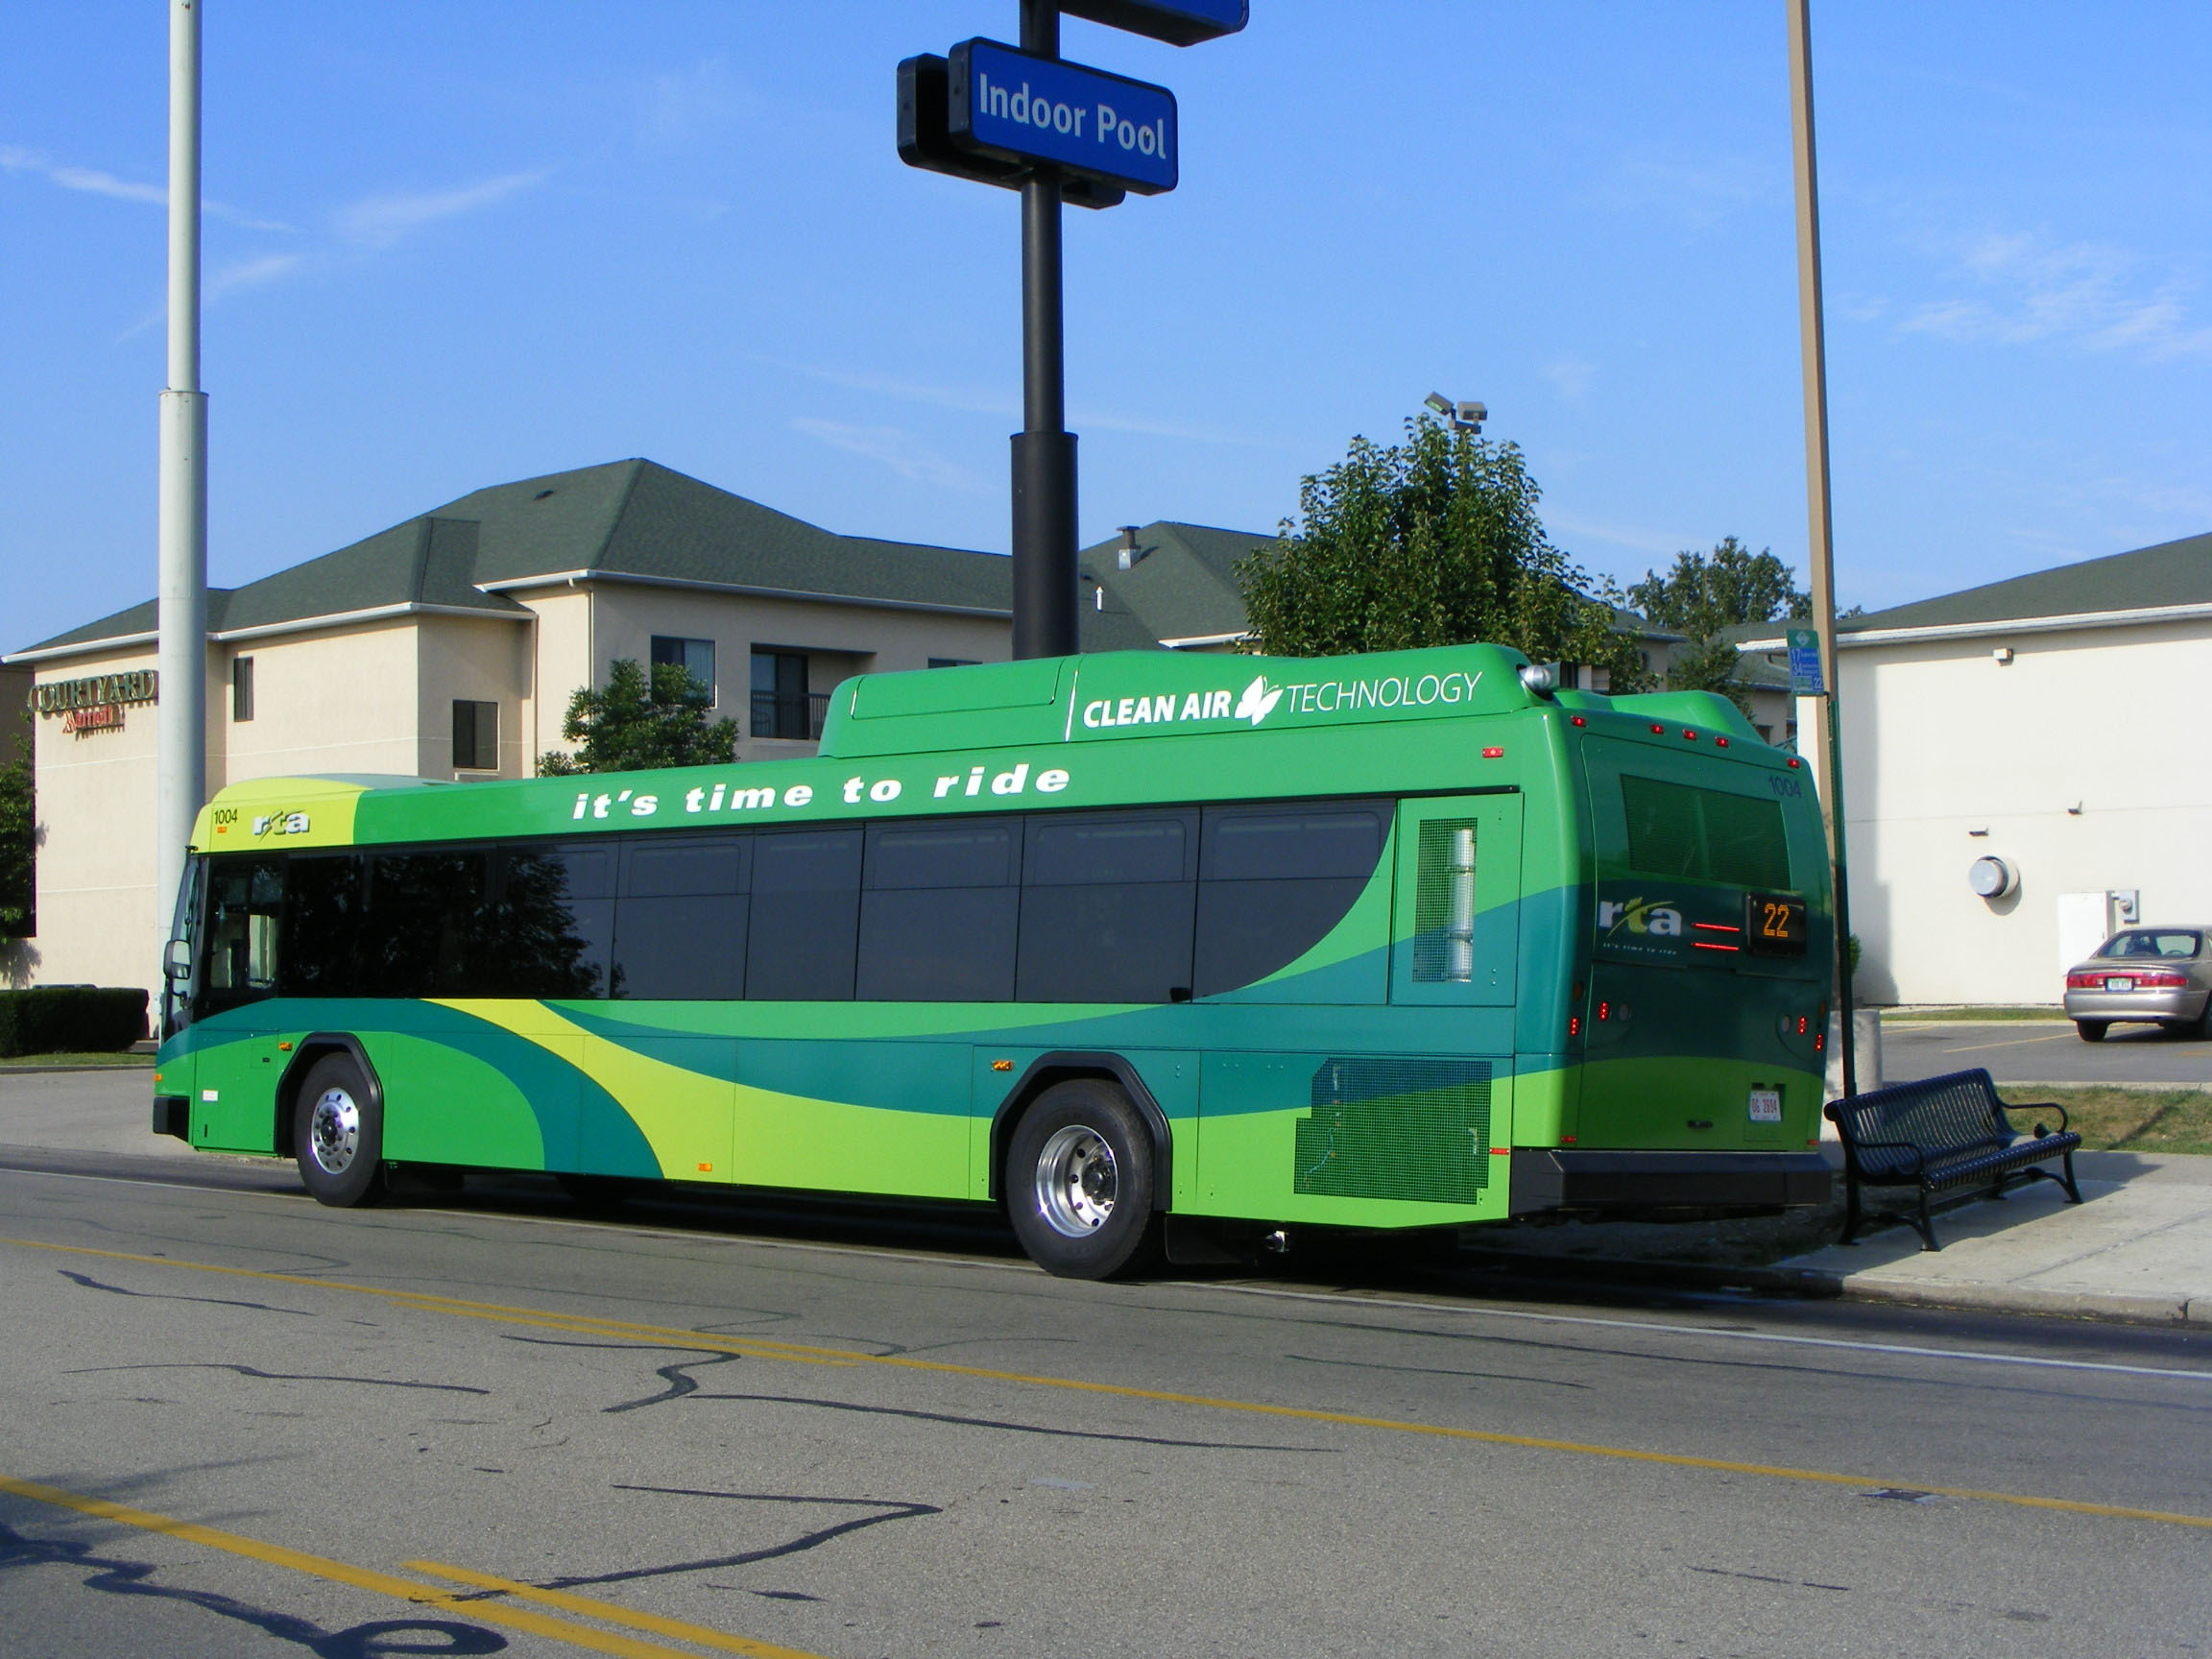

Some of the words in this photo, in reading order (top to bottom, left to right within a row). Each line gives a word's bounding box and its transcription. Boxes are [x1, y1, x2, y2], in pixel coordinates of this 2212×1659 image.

[979, 73, 1087, 138] Indoor
[1096, 103, 1166, 160] Pool
[27, 669, 156, 712] COURTYARD
[1083, 694, 1178, 729] CLEAN
[1180, 689, 1234, 721] AIR
[1286, 671, 1484, 714] TECHNOLOGY
[1813, 677, 1822, 689] 22
[571, 790, 660, 821] it's
[685, 782, 814, 814] time
[842, 775, 903, 805] to
[932, 763, 1071, 799] ride
[1767, 775, 1801, 799] 1004
[214, 808, 238, 825] 1004
[252, 808, 311, 841] rta
[1599, 897, 1683, 937] rta
[1763, 902, 1791, 938] 22
